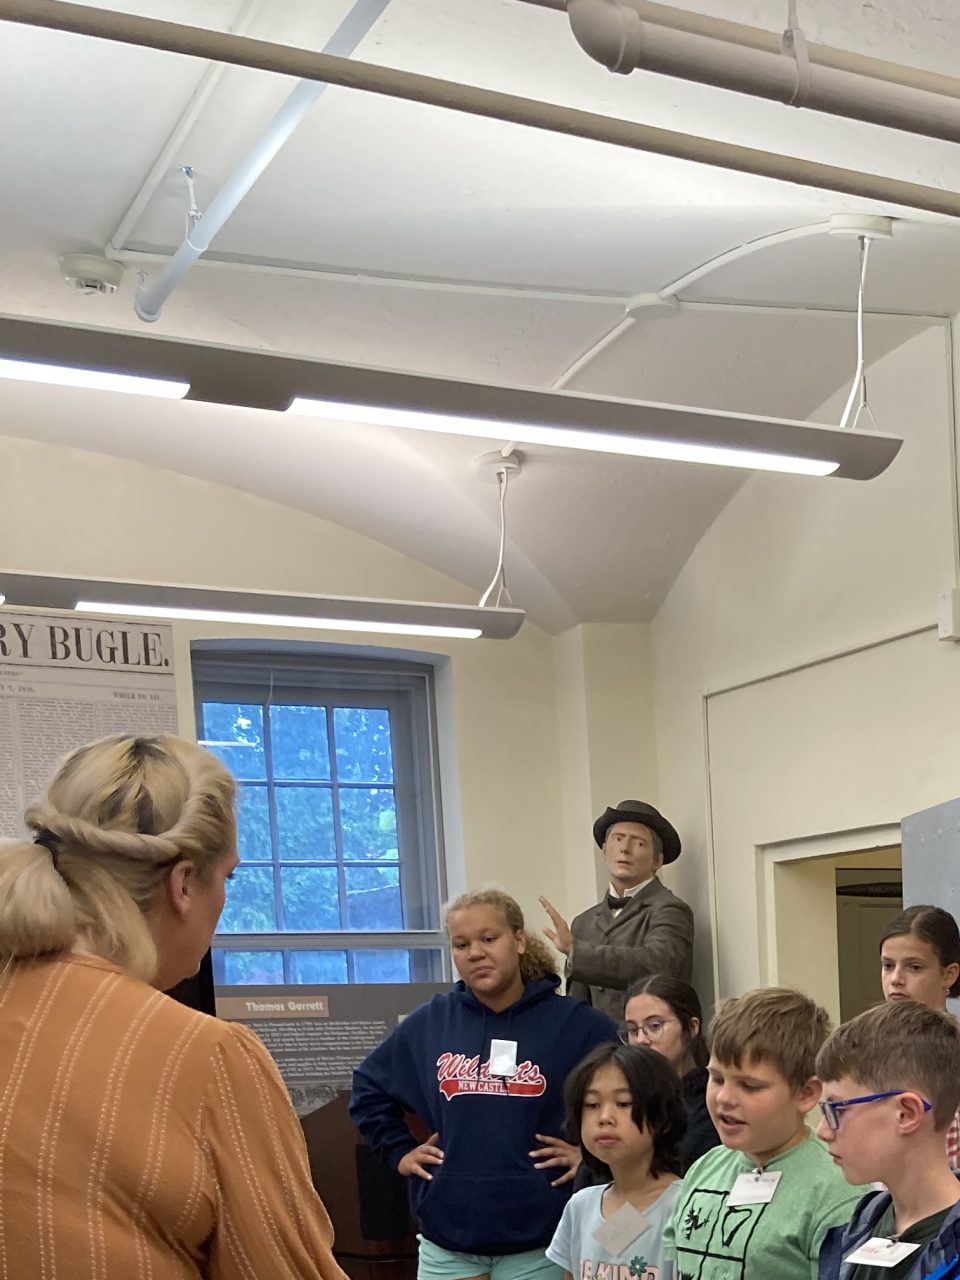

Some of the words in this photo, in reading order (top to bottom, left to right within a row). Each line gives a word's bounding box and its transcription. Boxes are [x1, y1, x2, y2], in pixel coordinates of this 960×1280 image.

[48, 625, 170, 667] BUGLE.
[245, 1001, 285, 1012] Thomas
[287, 1001, 324, 1012] Garrett
[436, 1052, 541, 1082] Wildts
[458, 1080, 477, 1091] NEW
